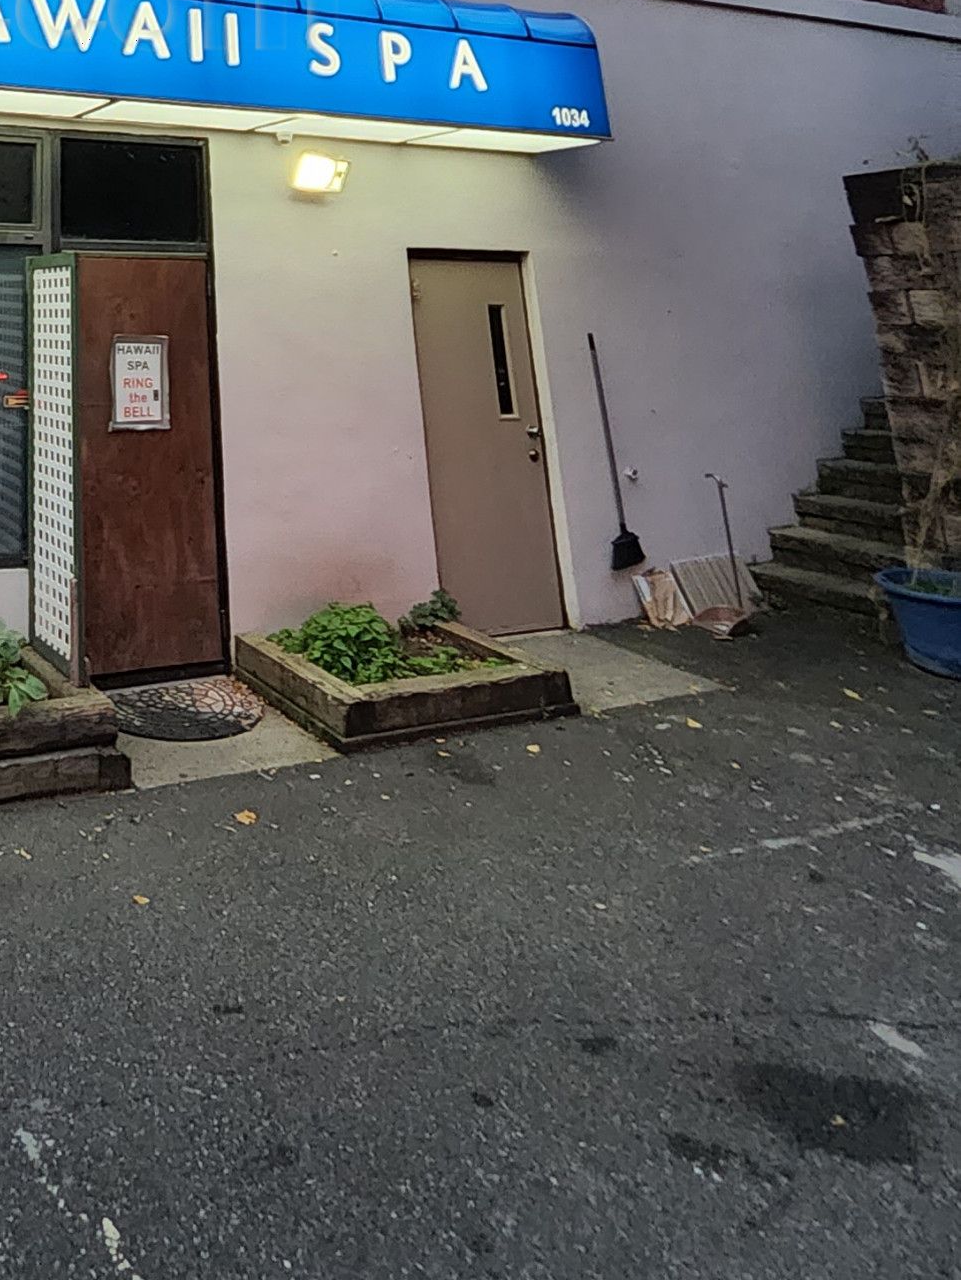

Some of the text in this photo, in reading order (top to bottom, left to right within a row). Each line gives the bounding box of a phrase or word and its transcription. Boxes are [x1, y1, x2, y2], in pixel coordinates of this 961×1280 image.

[308, 22, 488, 92] SPA
[551, 107, 590, 128] 1034
[117, 345, 159, 355] HAWAII
[127, 361, 149, 370] SPA
[123, 378, 153, 388] RING
[129, 392, 147, 402] the
[123, 406, 154, 417] BELL
